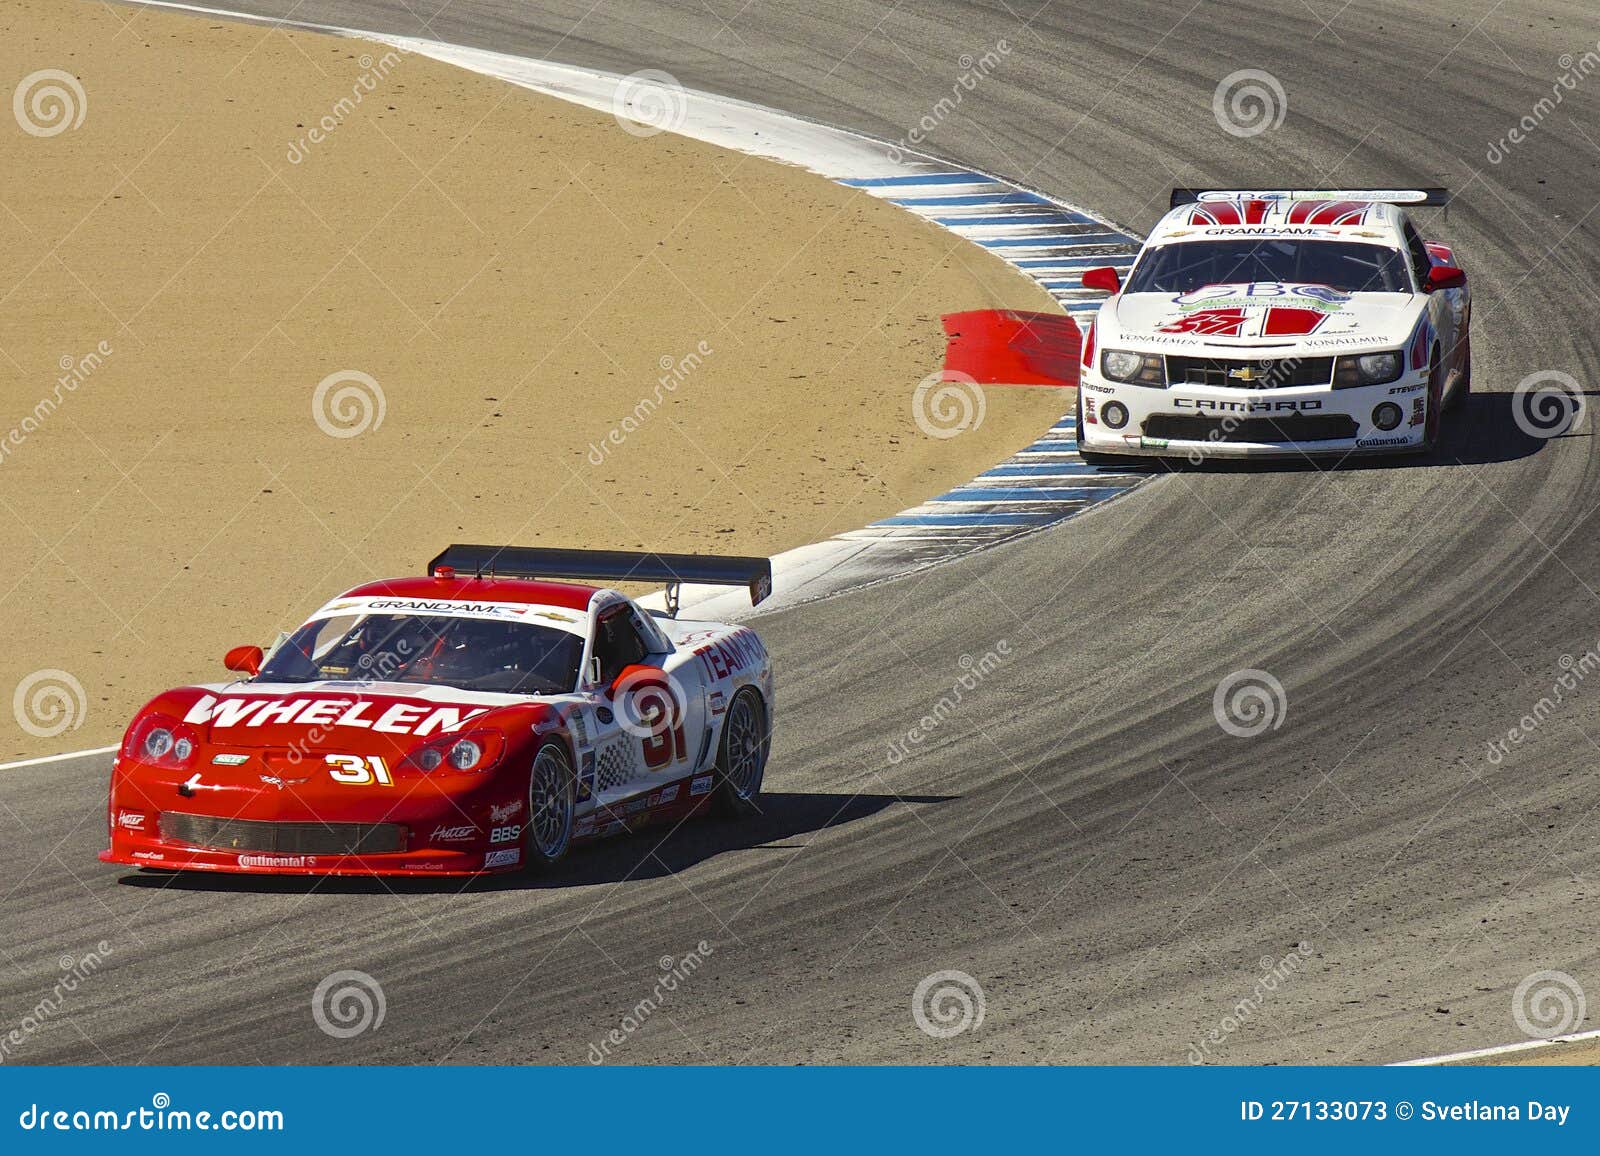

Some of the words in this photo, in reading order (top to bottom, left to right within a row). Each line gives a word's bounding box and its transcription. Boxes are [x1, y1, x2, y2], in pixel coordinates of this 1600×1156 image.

[1173, 398, 1323, 412] CAMARO
[182, 694, 488, 737] WHELEN
[325, 753, 394, 787] 31
[489, 824, 521, 843] BBS
[237, 854, 306, 868] Continental
[400, 862, 444, 870] rmorCoat
